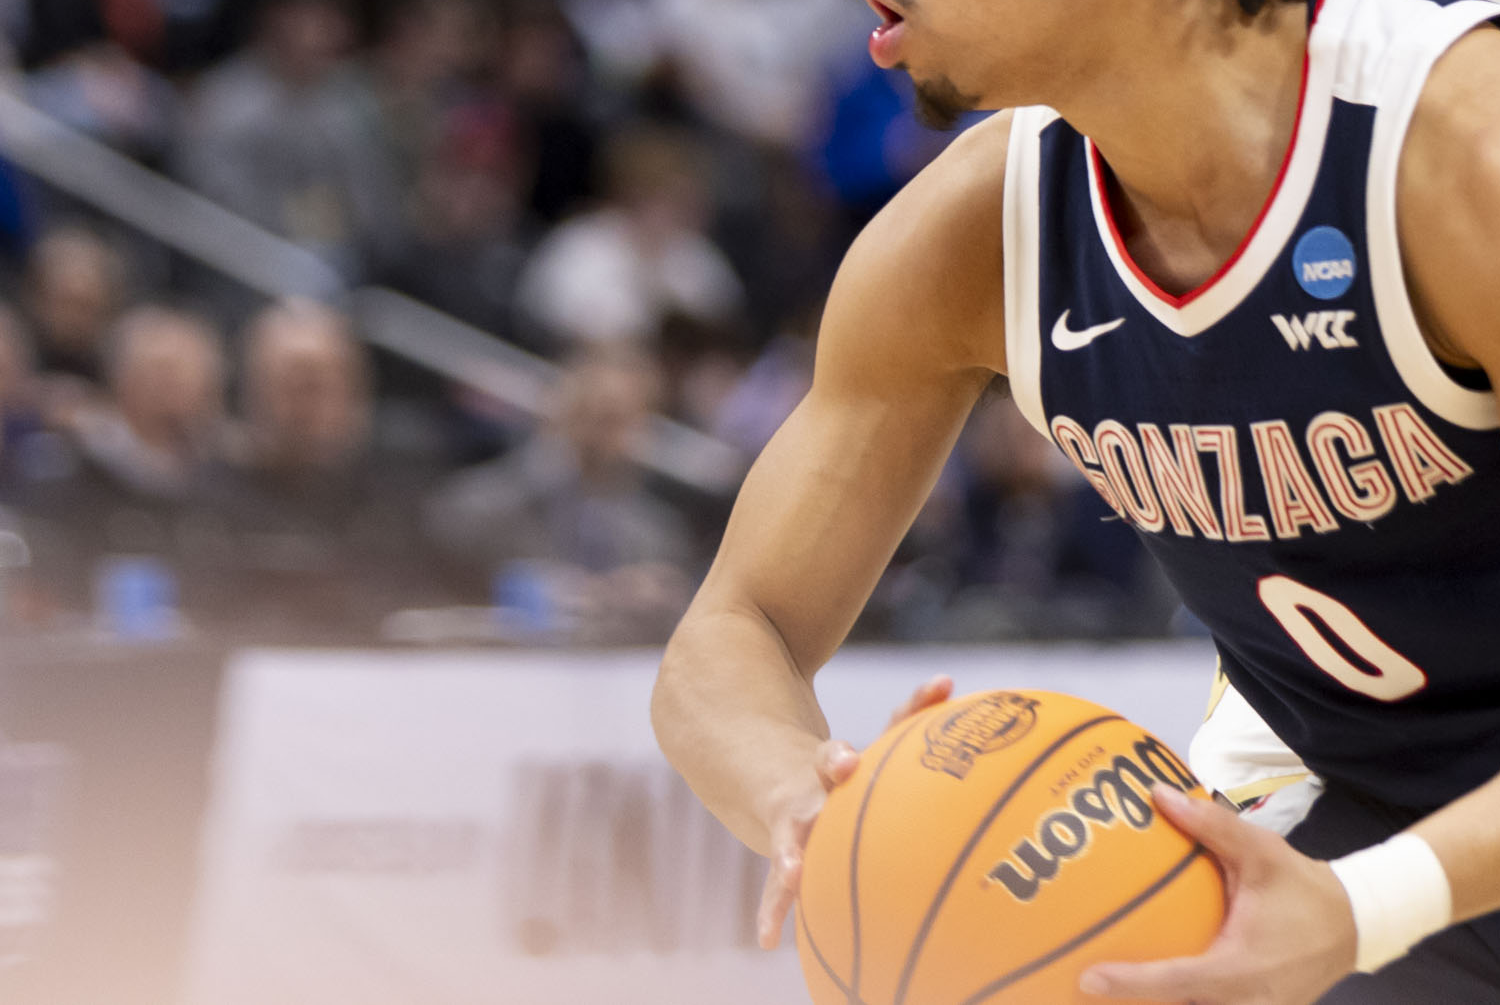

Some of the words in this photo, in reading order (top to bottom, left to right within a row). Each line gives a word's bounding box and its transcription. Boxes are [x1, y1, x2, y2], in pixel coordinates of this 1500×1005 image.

[1269, 310, 1360, 351] WCC
[1303, 259, 1353, 282] NCAA
[1050, 402, 1476, 543] GONZAGA
[1258, 574, 1427, 701] 0
[985, 734, 1201, 902] Wilson
